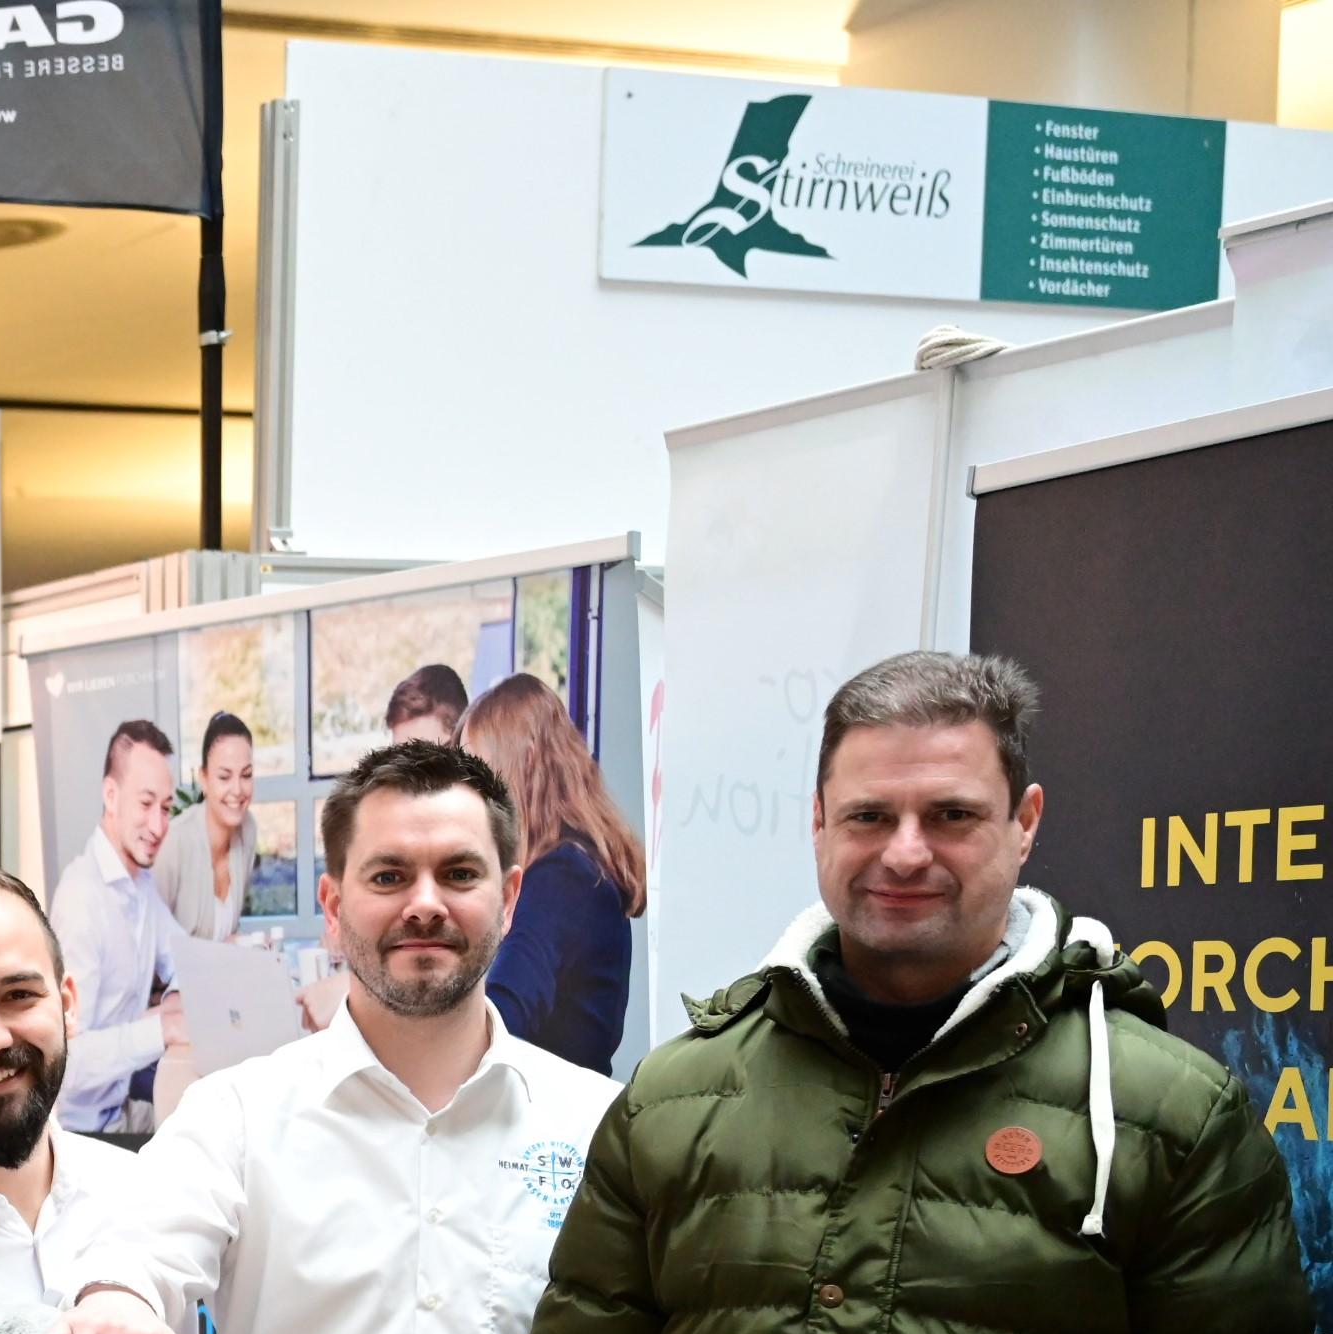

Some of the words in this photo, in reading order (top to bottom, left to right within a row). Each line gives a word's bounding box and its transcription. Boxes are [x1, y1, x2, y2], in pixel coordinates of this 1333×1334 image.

[1044, 119, 1100, 140] Fenster
[1044, 143, 1119, 165] Haustüren
[813, 153, 915, 182] Schreinerei
[1043, 165, 1115, 187] Fußböden
[682, 154, 952, 247] Stirnweiß
[1042, 187, 1152, 212] Einbruchschutz
[1041, 210, 1141, 234] Sonnenschutz
[1040, 232, 1134, 255] Zimmertüren
[1039, 254, 1150, 278] Insektenschutz
[1038, 277, 1111, 298] Vordächer
[1140, 804, 1325, 889] INTE
[1113, 936, 1333, 1013] ORCH
